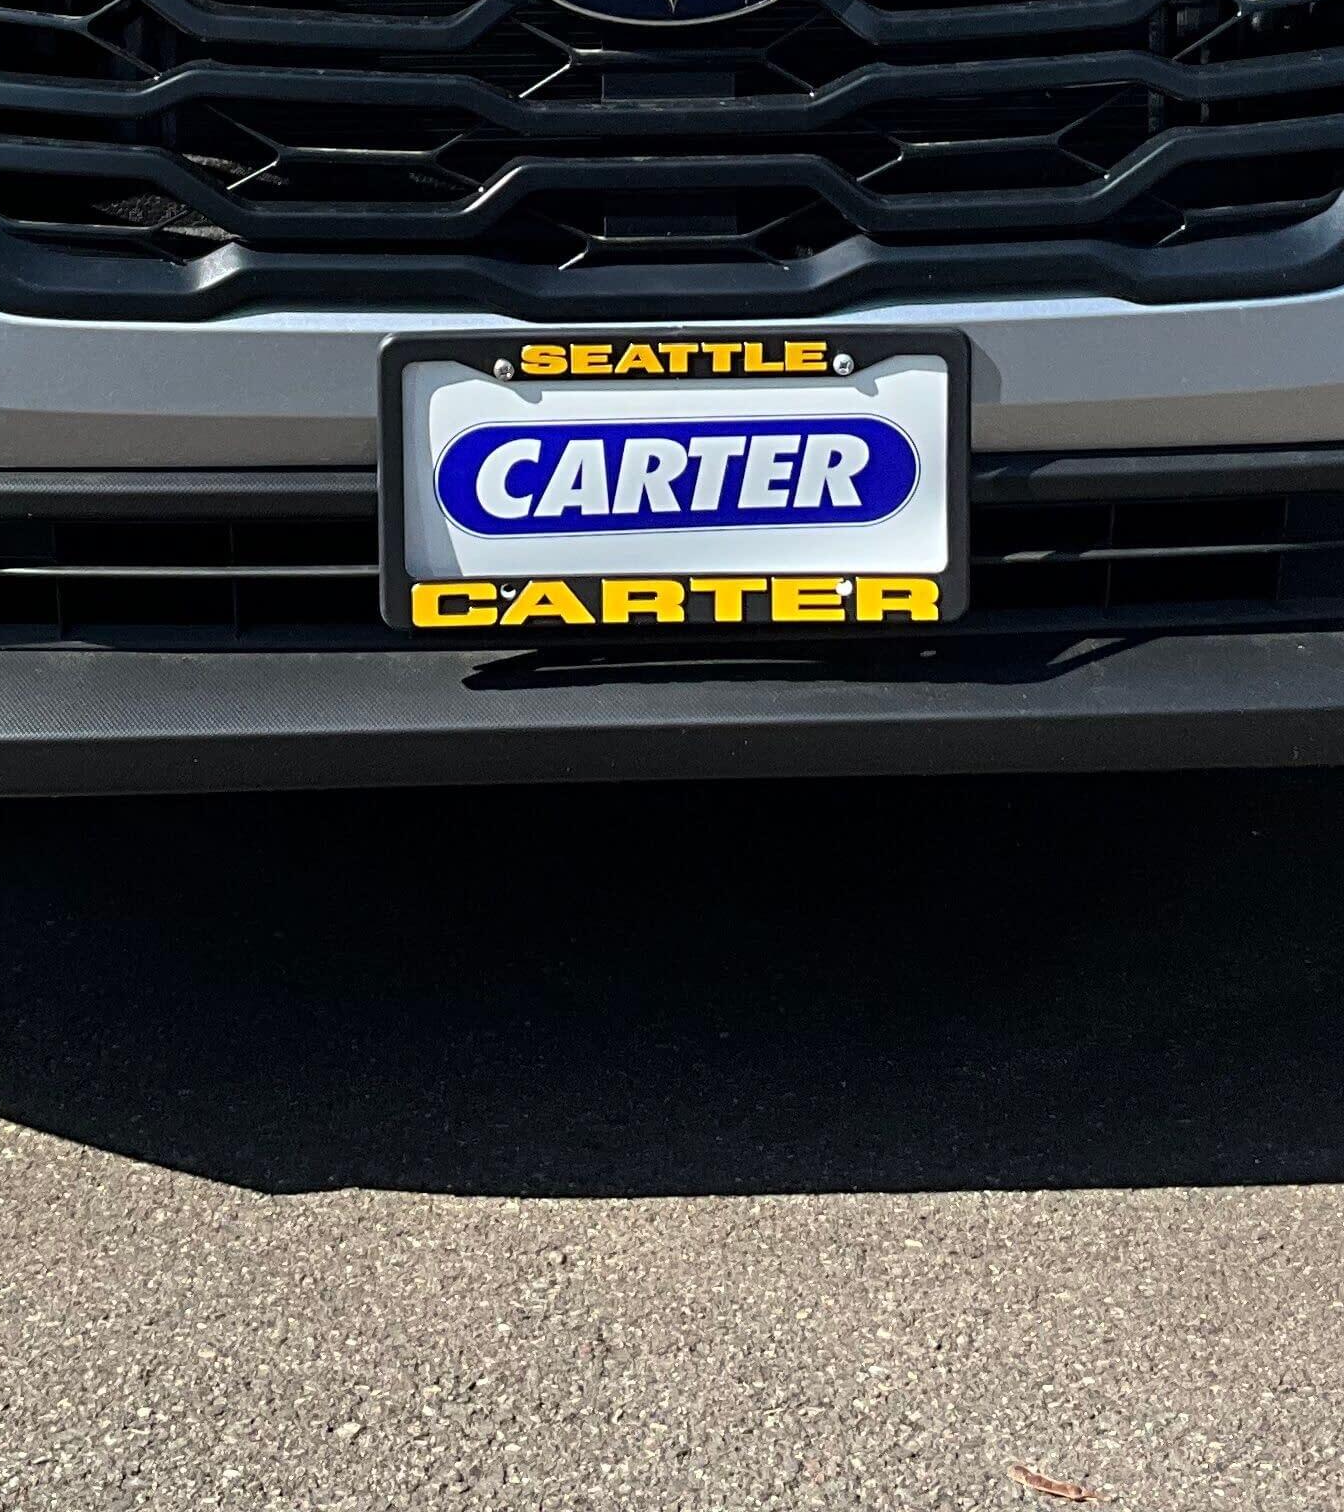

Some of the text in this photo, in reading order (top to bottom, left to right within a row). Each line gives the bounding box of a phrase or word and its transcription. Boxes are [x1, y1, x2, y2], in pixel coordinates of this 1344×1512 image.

[520, 341, 828, 375] SEATTLE
[475, 433, 871, 520] CARTER
[410, 577, 940, 628] CARTER
